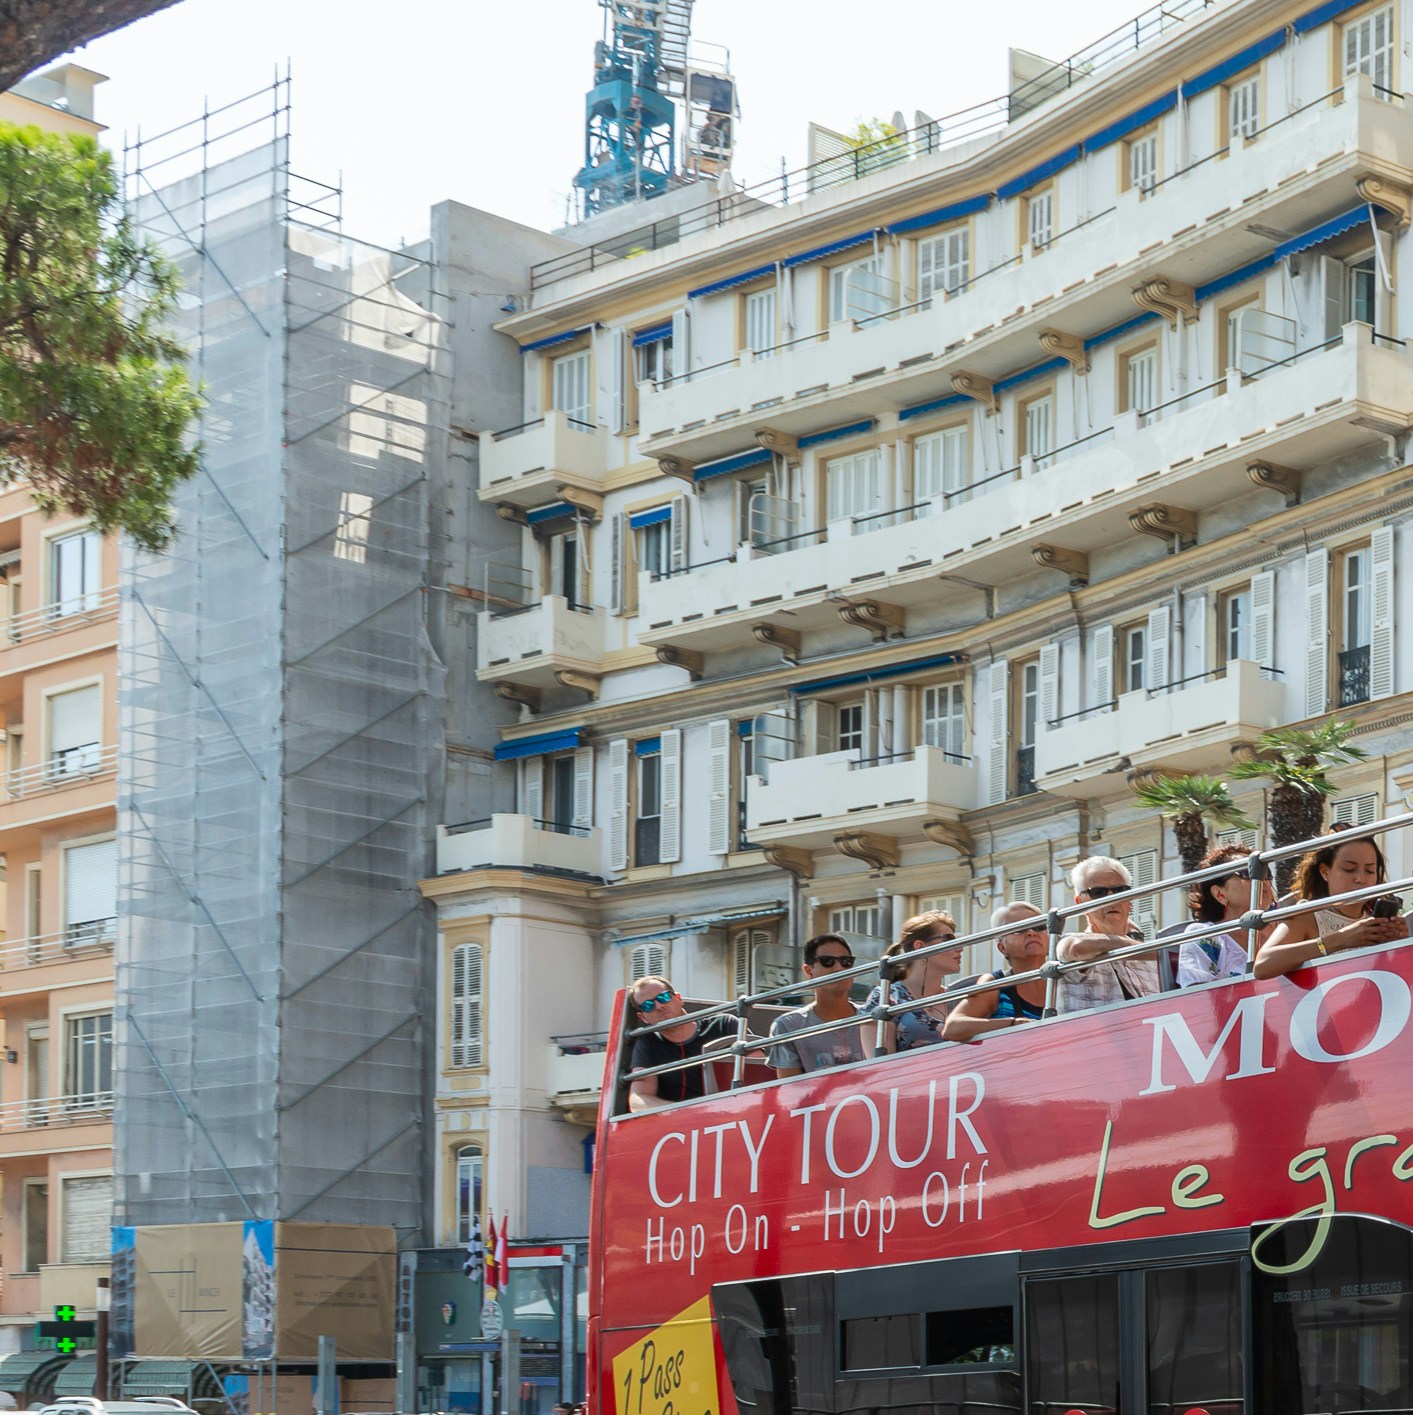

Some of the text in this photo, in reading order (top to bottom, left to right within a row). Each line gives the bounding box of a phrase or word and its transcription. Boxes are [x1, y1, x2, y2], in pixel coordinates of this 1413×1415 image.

[649, 1072, 988, 1208] CITY TOUR
[1089, 1119, 1225, 1229] Le
[646, 1216, 704, 1275] Hop
[725, 1203, 769, 1253] On
[824, 1187, 895, 1252] Hop
[923, 1160, 987, 1227] Off
[638, 1340, 685, 1415] Pass
